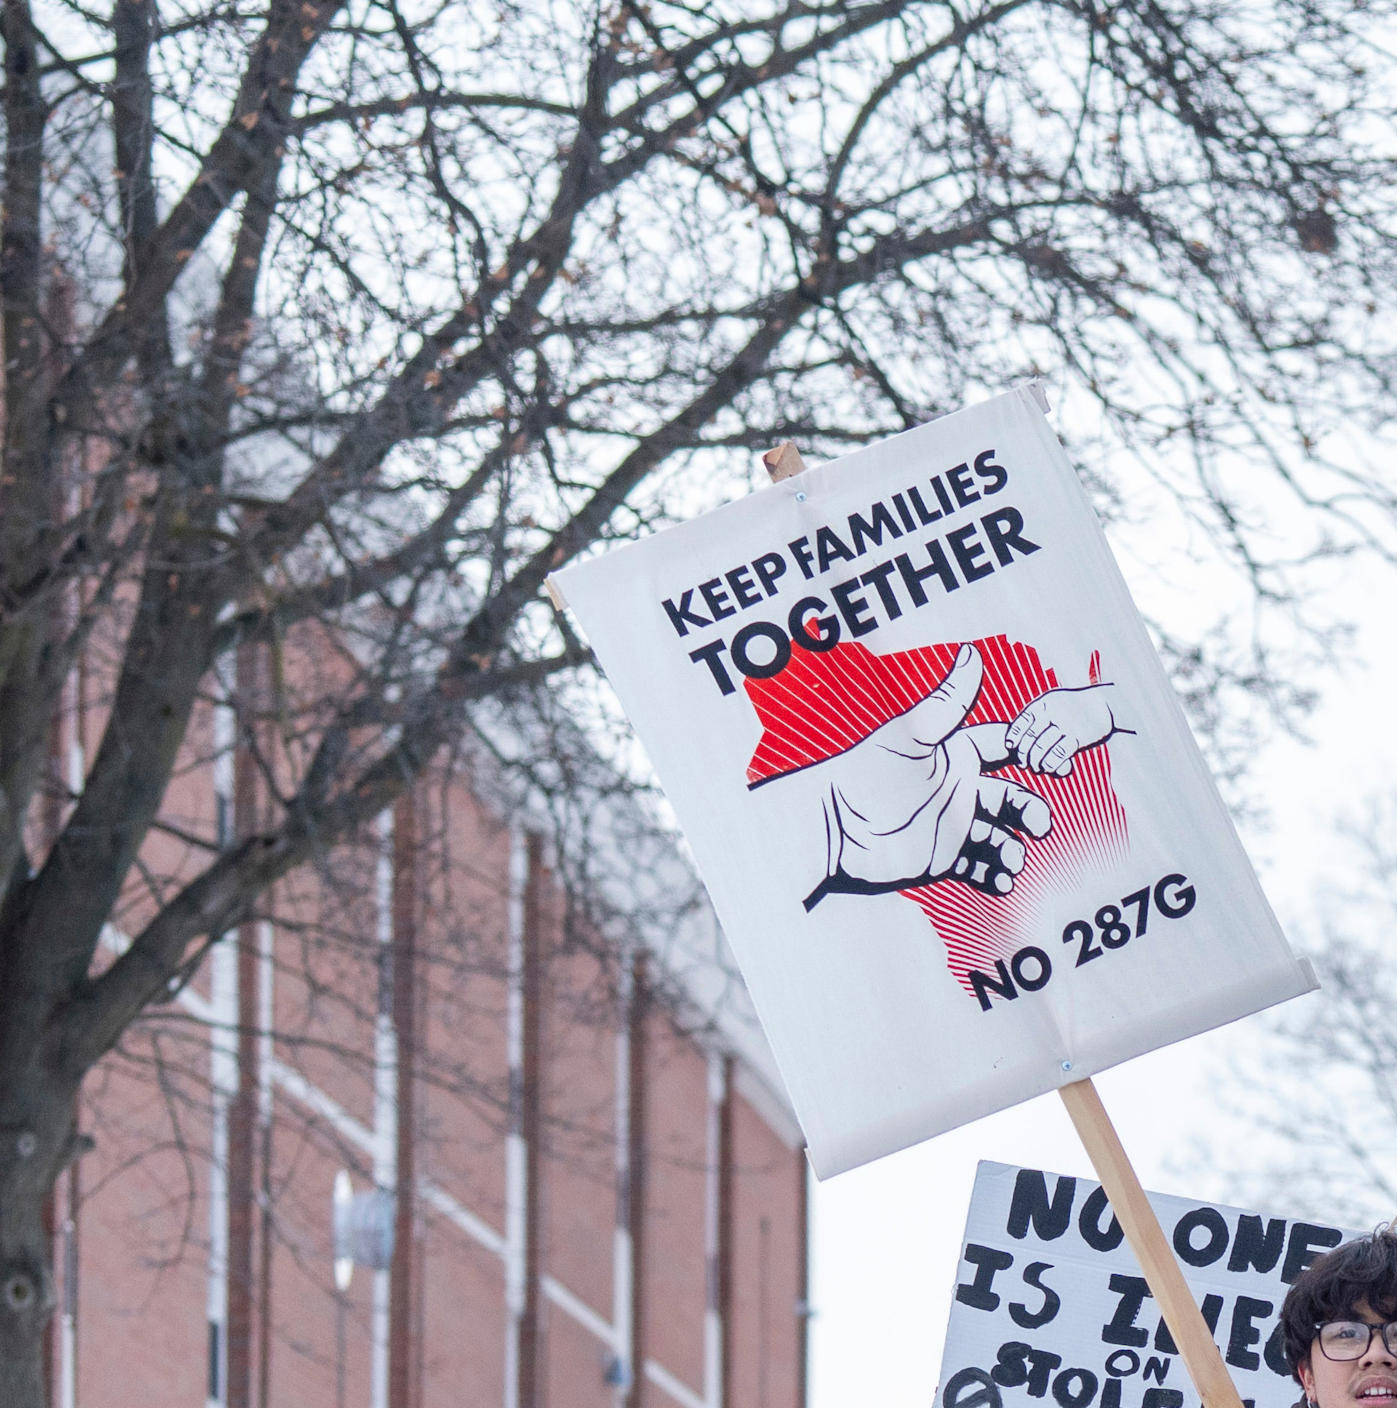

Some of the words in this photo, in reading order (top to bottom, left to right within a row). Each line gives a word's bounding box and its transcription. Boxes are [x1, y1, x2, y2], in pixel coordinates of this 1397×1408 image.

[662, 552, 787, 637] KEEP
[788, 449, 1008, 582] FAMILIES
[690, 506, 1042, 696] TOGETHER
[968, 946, 1053, 1012] NO
[1062, 872, 1197, 968] 287G
[956, 1243, 1060, 1329] IS
[1006, 1169, 1125, 1252] NO
[1173, 1207, 1342, 1285] ONE
[1105, 1349, 1171, 1386] ON
